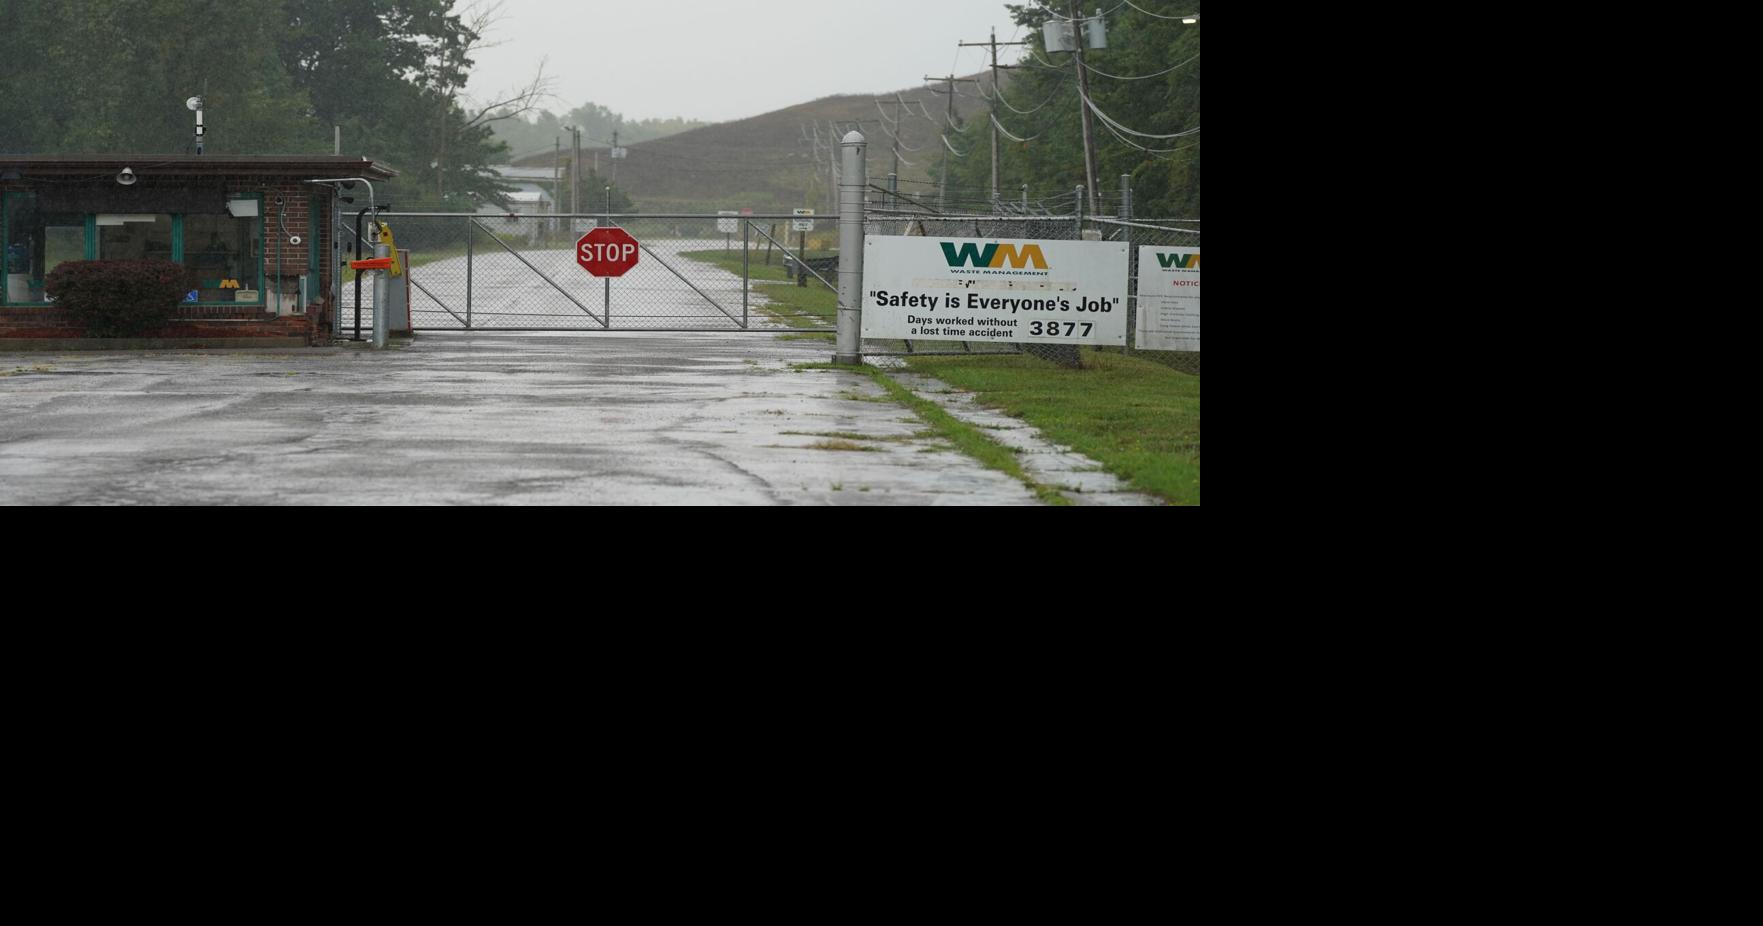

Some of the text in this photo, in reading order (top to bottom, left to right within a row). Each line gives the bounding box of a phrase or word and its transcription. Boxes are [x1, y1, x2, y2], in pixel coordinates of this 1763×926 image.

[580, 243, 635, 262] STOP
[940, 242, 1049, 269] WM
[870, 290, 1119, 314] "Safety is Everyone's Job"
[907, 315, 1018, 327] Days worked without
[1029, 321, 1093, 337] 3877
[920, 326, 940, 336] lost
[943, 327, 966, 336] time
[968, 328, 1013, 338] accident
